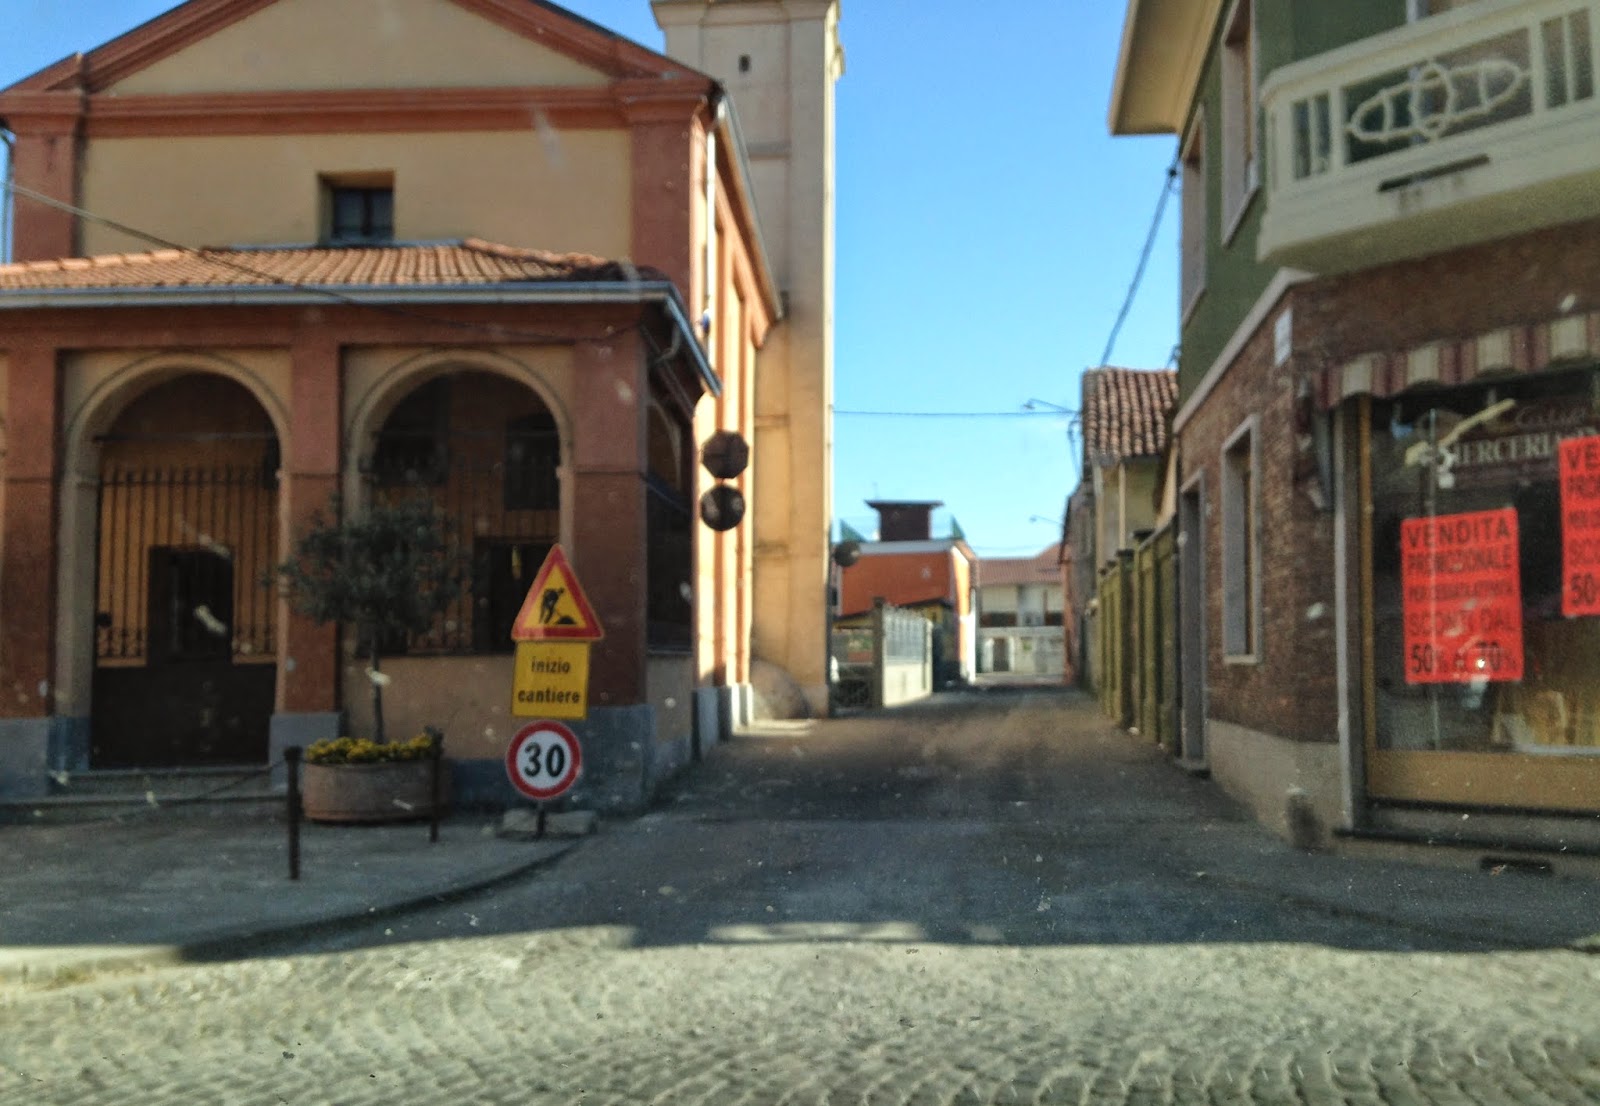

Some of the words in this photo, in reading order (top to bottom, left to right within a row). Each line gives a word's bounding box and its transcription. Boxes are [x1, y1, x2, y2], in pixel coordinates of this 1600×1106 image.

[1407, 517, 1511, 548] VENDITA
[531, 656, 571, 674] inizio
[518, 689, 580, 704] cantiere
[524, 742, 565, 777] 30
